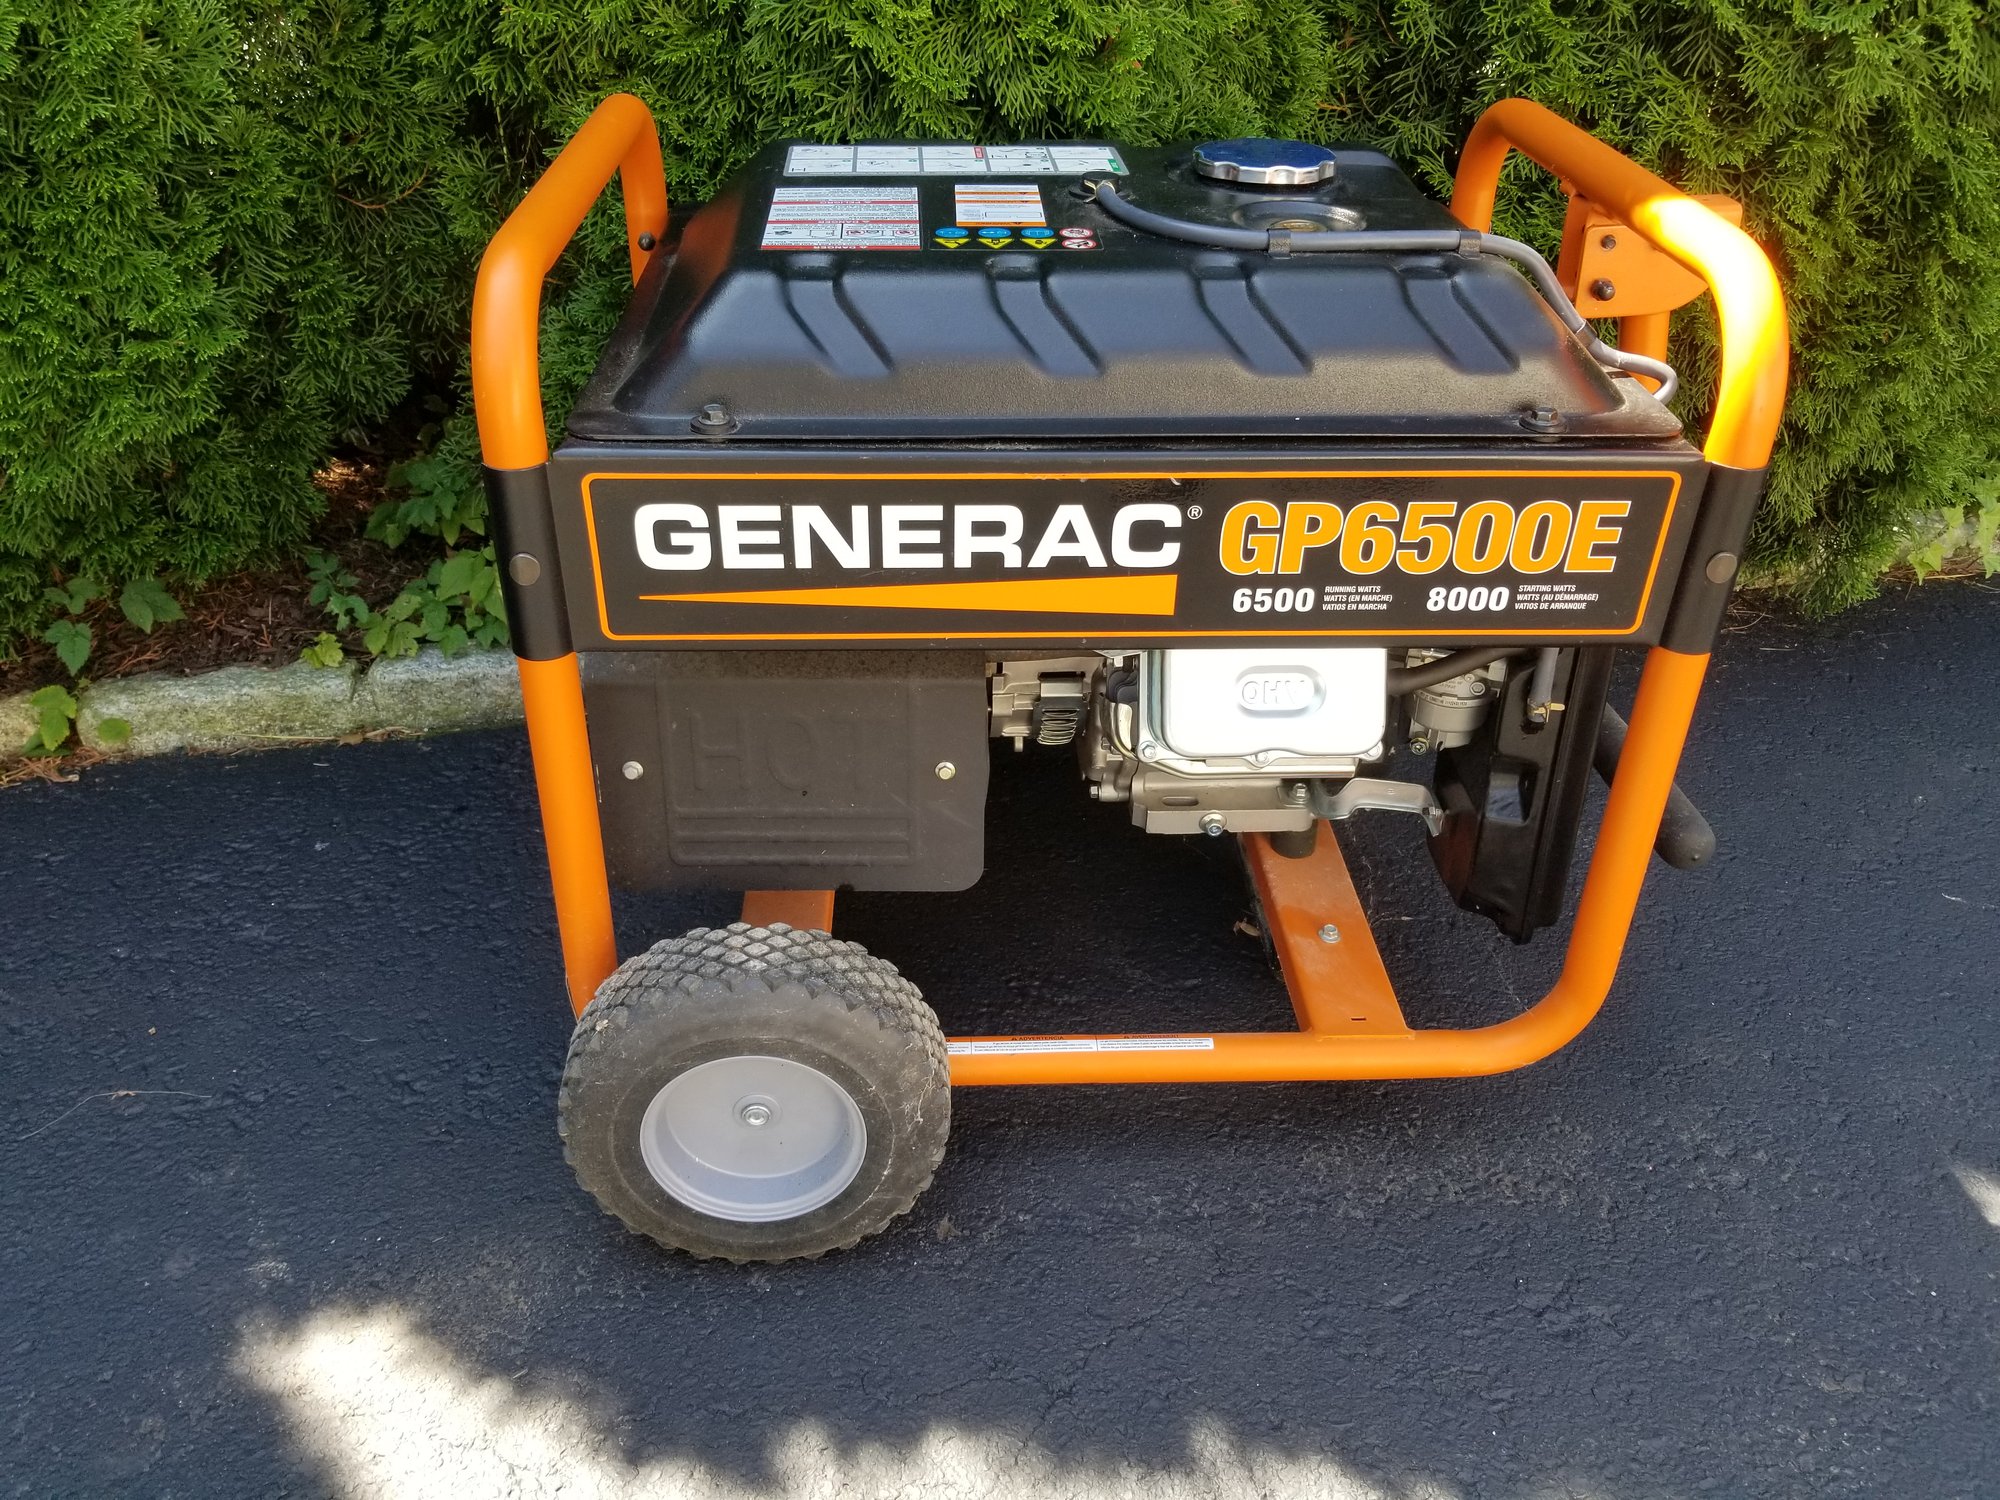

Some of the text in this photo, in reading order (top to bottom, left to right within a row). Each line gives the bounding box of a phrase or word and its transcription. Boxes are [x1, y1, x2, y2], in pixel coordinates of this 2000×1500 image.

[633, 503, 1182, 571] GENERAC
[1219, 500, 1632, 576] GP6500E
[1324, 585, 1381, 593] RUNNING WATTS
[1232, 587, 1315, 613] 6500
[1323, 594, 1393, 603] WATTS (EN MARCHE)
[1426, 586, 1510, 612] 8000
[1516, 593, 1541, 601] WATTS
[1541, 593, 1554, 602] (AU
[1322, 603, 1387, 611] VATIOS EN MARCHA
[1514, 602, 1587, 611] VATIOS DE ARRANQUE
